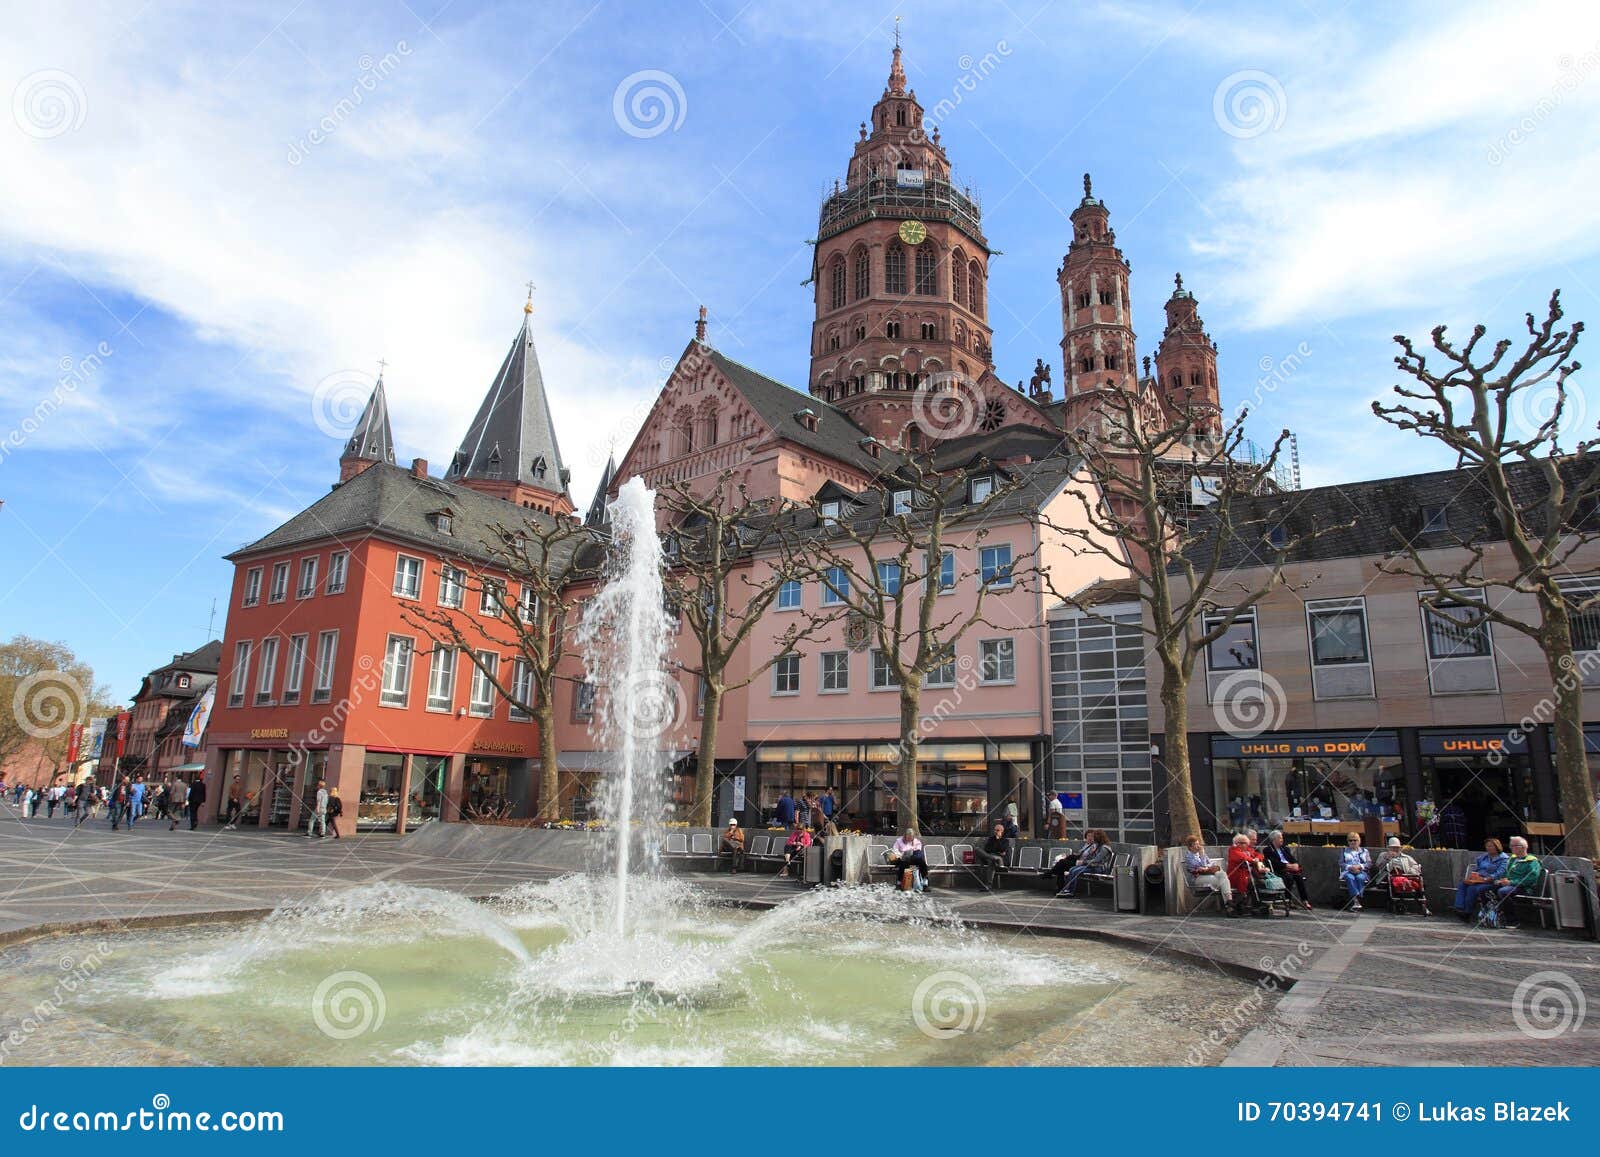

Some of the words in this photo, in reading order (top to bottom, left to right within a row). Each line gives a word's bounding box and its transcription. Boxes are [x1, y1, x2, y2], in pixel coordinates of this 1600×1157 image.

[251, 728, 289, 738] SALAMANDER
[1241, 744, 1291, 754] UHLIG
[1296, 745, 1319, 753] am
[1324, 743, 1367, 753] DOM
[1443, 739, 1502, 750] UHLIG
